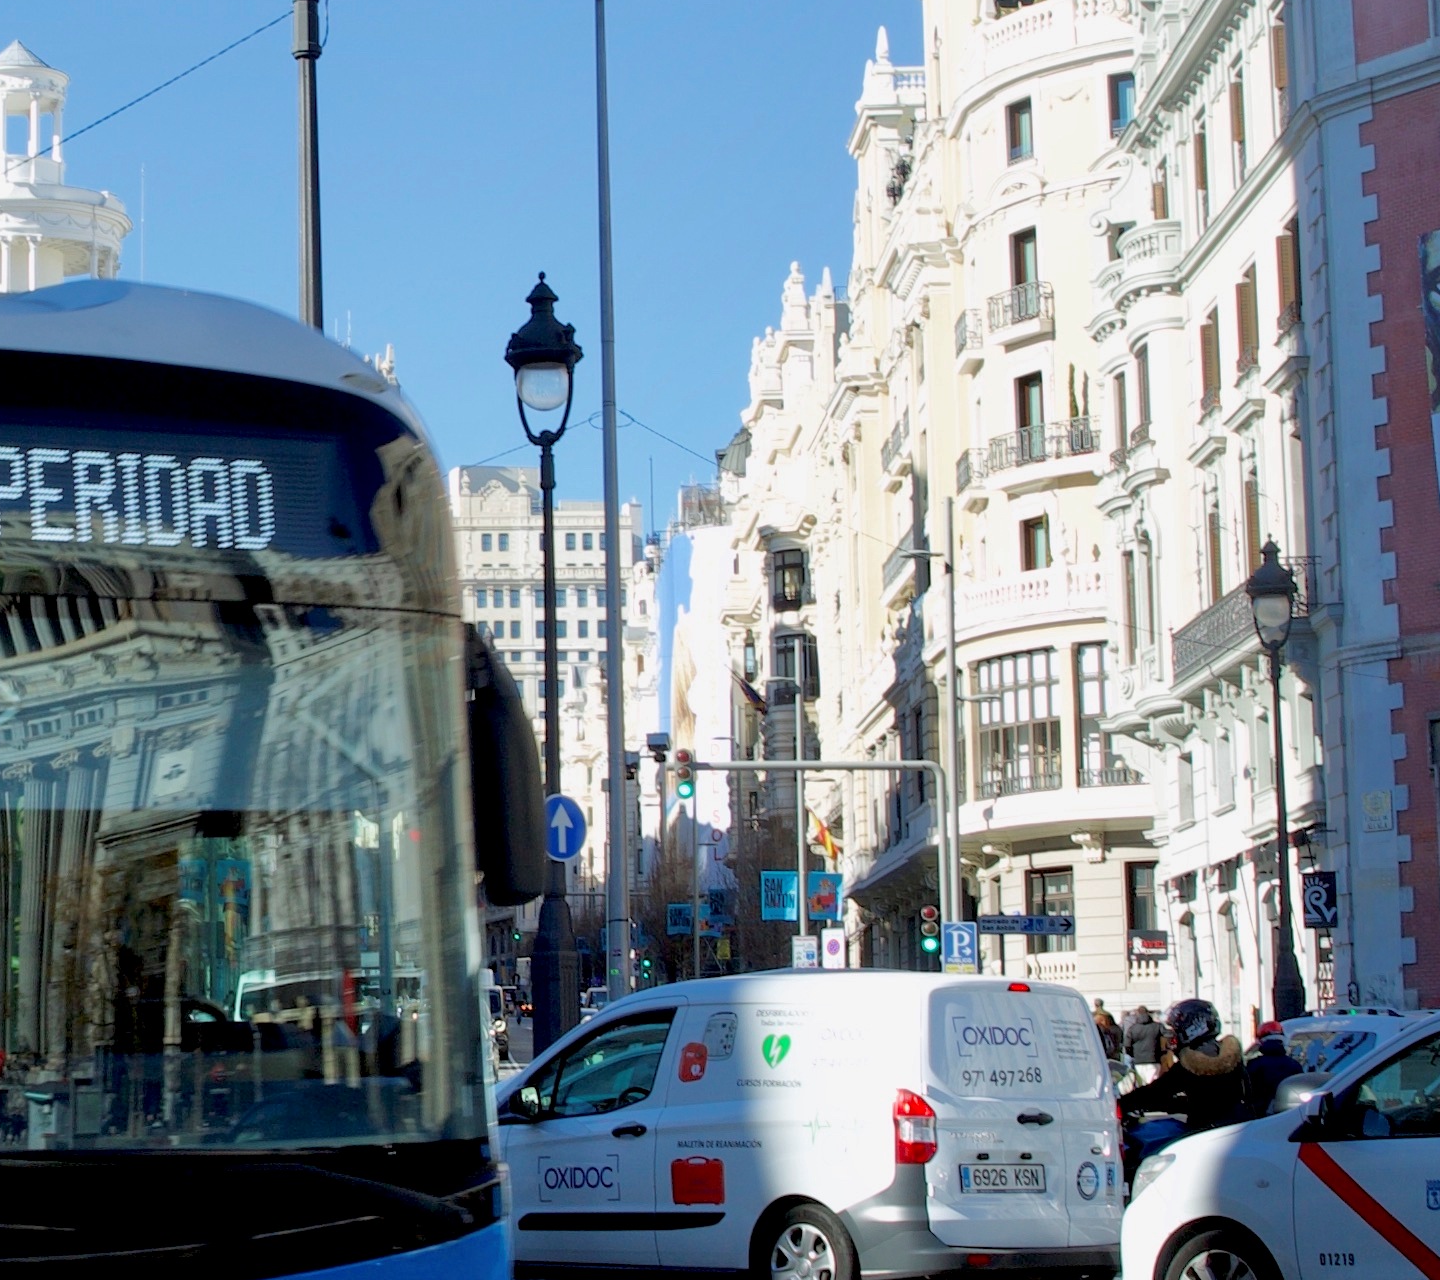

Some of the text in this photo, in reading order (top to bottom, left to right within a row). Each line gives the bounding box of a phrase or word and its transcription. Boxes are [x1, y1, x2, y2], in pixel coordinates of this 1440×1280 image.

[763, 878, 782, 892] SAN
[962, 1026, 1031, 1047] OXIDOC
[962, 1067, 1042, 1087] 971 497 268
[544, 1166, 613, 1189] OXIDOC
[973, 1168, 1040, 1186] 6926 KSN
[1319, 1253, 1355, 1266] 01219
